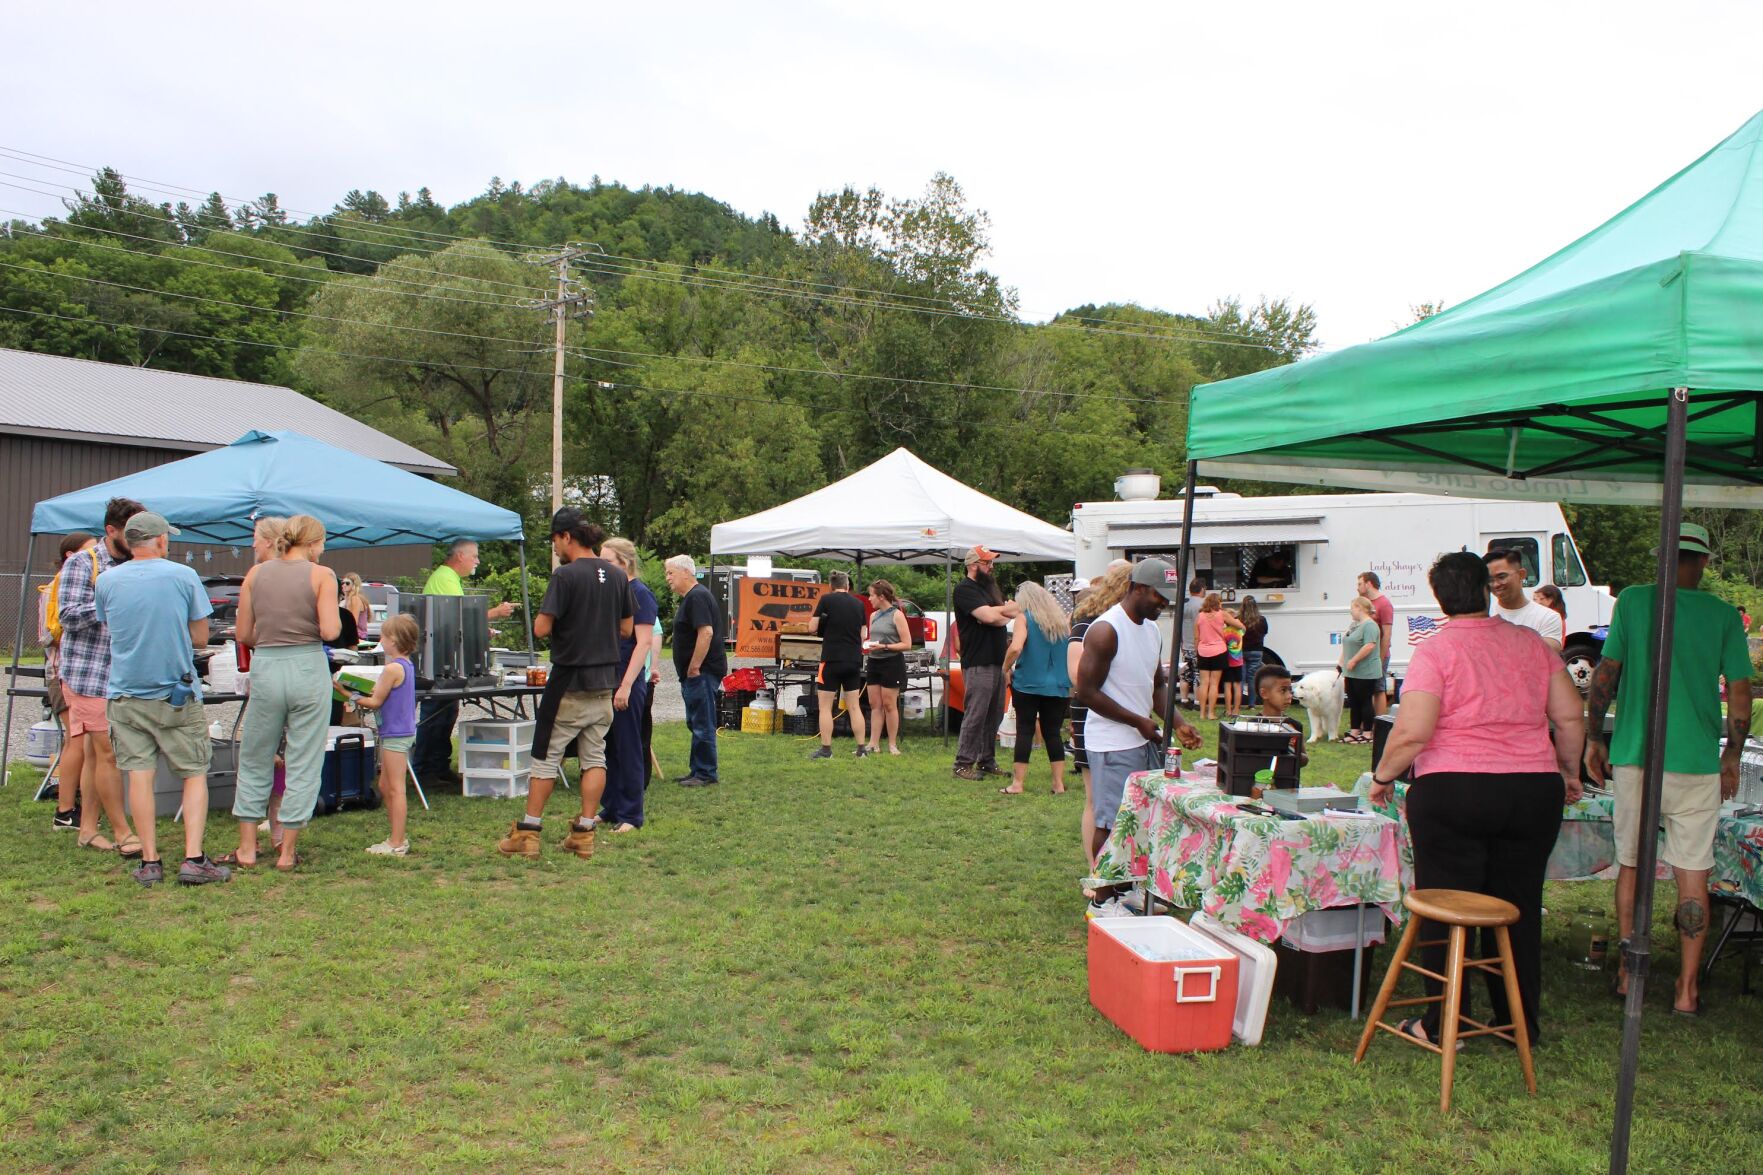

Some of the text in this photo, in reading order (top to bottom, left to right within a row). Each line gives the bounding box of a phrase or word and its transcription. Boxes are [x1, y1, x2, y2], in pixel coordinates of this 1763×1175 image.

[1370, 561, 1391, 576] Lady
[753, 582, 821, 600] CHEF
[1384, 581, 1416, 597] atering
